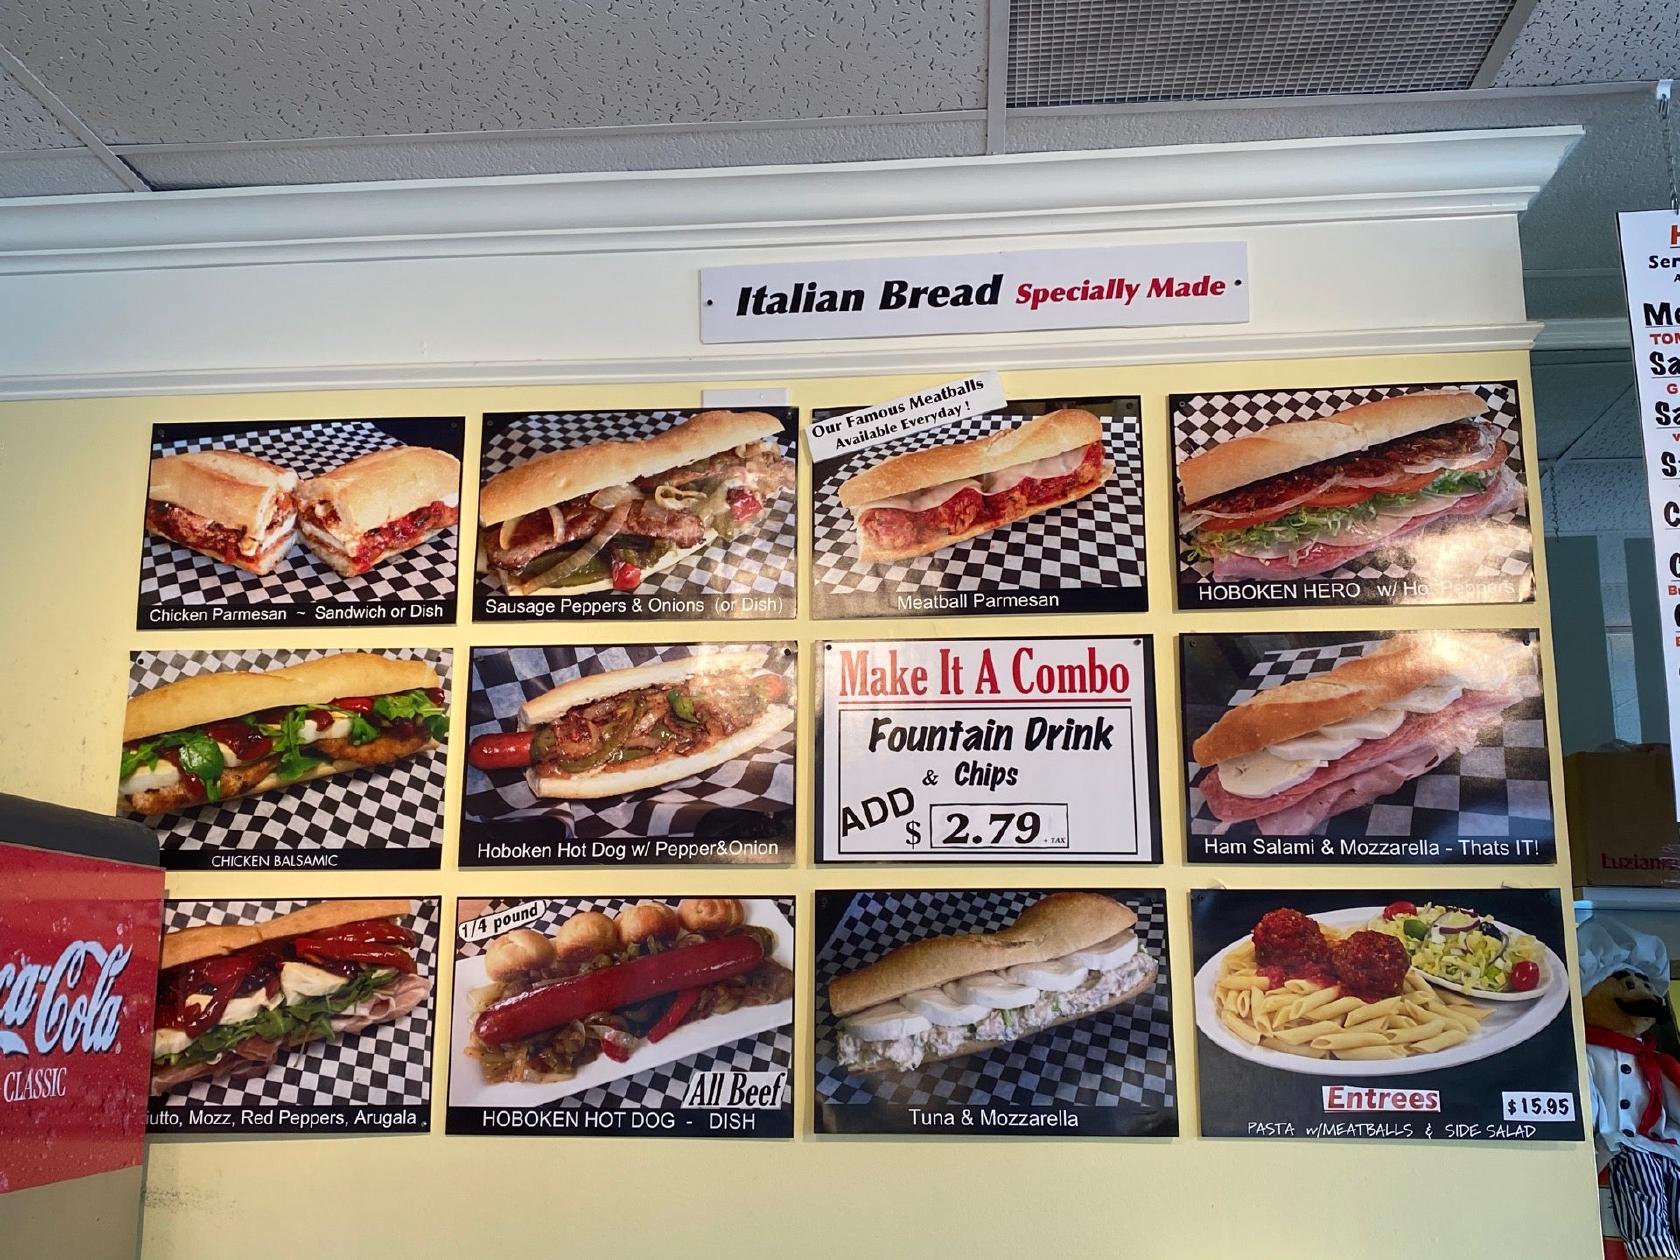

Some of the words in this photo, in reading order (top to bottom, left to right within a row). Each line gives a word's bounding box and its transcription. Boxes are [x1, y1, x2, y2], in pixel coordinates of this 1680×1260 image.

[736, 283, 864, 316] Italian
[879, 274, 1004, 311] Bread
[1015, 278, 1139, 310] Specially
[1146, 275, 1226, 298] Made
[812, 421, 842, 438] Our
[846, 403, 905, 427] Famous
[909, 379, 984, 410] Meatballs
[836, 422, 898, 450] Available
[900, 405, 962, 430] Everyday
[1199, 584, 1297, 601] HOBOKEN
[1303, 582, 1360, 599] HERO
[1377, 582, 1397, 597] w/
[1403, 581, 1433, 596] Ho
[485, 599, 555, 616] Sausage
[561, 598, 627, 616] Peppers
[632, 599, 643, 613] &
[648, 598, 704, 612] Onions
[715, 597, 736, 614] (or
[742, 597, 783, 614] Dish)
[898, 593, 967, 610] Meatball
[973, 594, 1060, 608] Parmesan
[150, 608, 208, 622] Chicken
[213, 607, 287, 621] Parmesan
[315, 605, 386, 620] Sandwich
[391, 607, 406, 618] or
[411, 604, 443, 618] Dish
[840, 649, 928, 697] Make
[939, 648, 963, 695] It
[975, 648, 1000, 695] A
[1012, 647, 1130, 695] Combo
[868, 716, 1013, 753] Fountain
[1024, 716, 1114, 751] Drink
[922, 769, 939, 786] &
[955, 760, 1019, 792] Chips
[841, 786, 915, 837] ADD
[905, 820, 921, 850] $
[942, 812, 1041, 845] 2.79
[478, 843, 551, 859] Hoboken
[558, 843, 586, 858] Hot
[592, 842, 626, 860] Dog
[631, 841, 650, 857] w/
[656, 840, 779, 860] Pepper&Onion
[1204, 839, 1247, 855] Ham
[1253, 838, 1315, 855] Salami
[1321, 839, 1334, 855] &
[1340, 839, 1440, 856] Mozzarella
[1458, 839, 1510, 856] Thats
[1516, 839, 1540, 856] IT!
[211, 855, 270, 867] CHICKEN
[274, 854, 338, 867] BALSAMIC
[1601, 853, 1678, 870] Luzian
[462, 918, 487, 938] 1/4
[494, 902, 538, 933] pound
[3, 1067, 67, 1103] CLASSIC
[688, 1072, 724, 1107] All
[727, 1072, 786, 1106] Beef
[1327, 1086, 1438, 1110] Entrees
[1507, 1097, 1569, 1116] $15.95
[146, 1110, 183, 1127] iutto,
[189, 1111, 235, 1127] Mozz,
[241, 1110, 273, 1124] Red
[279, 1110, 348, 1128] Peppers,
[354, 1110, 417, 1127] Arugala
[483, 1110, 579, 1128] HOBOKEN
[585, 1111, 626, 1128] HOT
[631, 1112, 675, 1129] DOG
[709, 1112, 755, 1130] DISH
[908, 1108, 954, 1126] Tuna
[961, 1109, 974, 1126] &
[980, 1109, 1078, 1127] Mozzarella
[1248, 1121, 1295, 1136] PASTA
[1444, 1123, 1481, 1138] SIDE
[1488, 1123, 1536, 1138] SALAD
